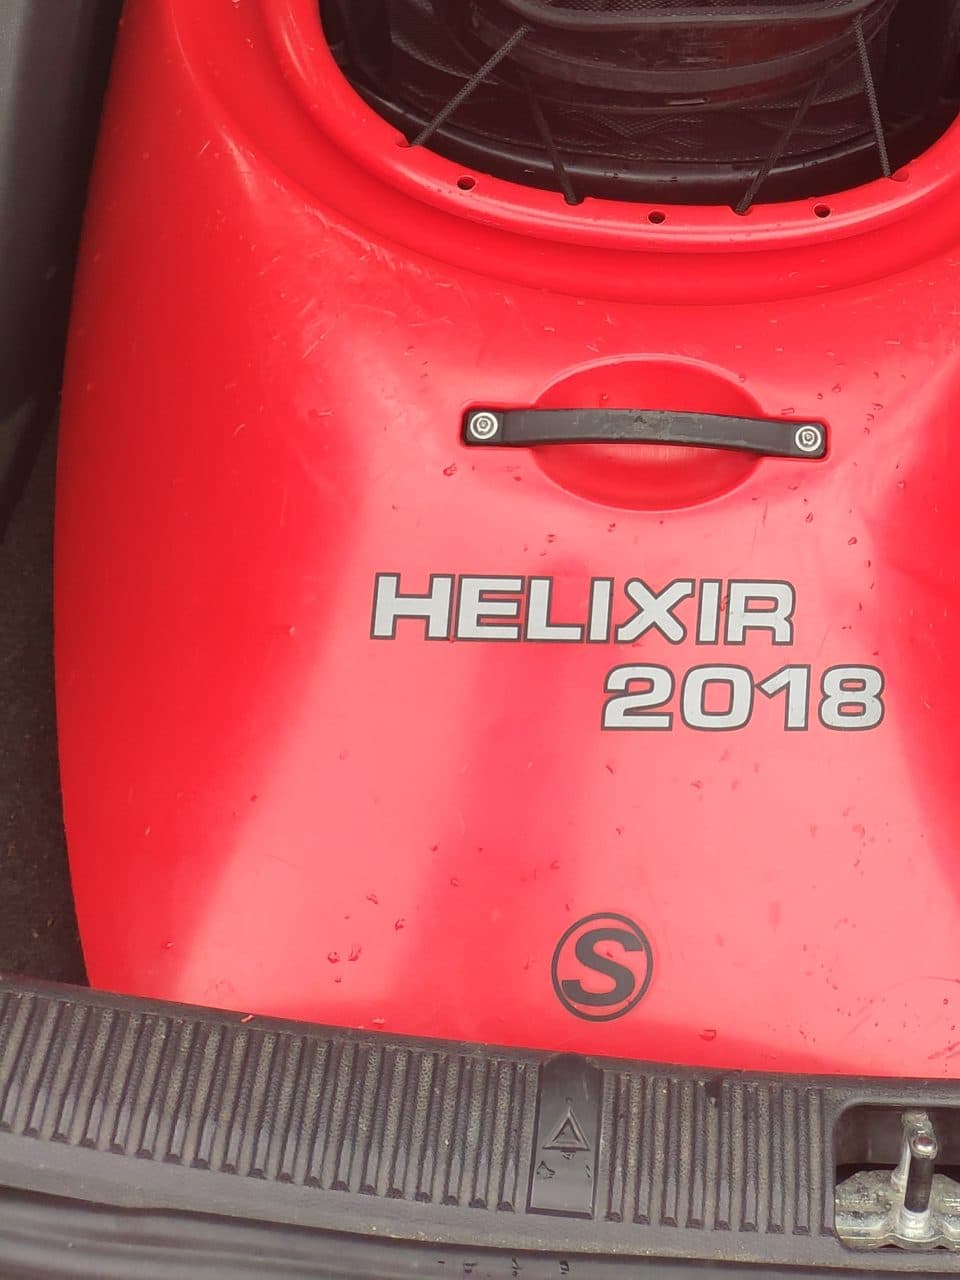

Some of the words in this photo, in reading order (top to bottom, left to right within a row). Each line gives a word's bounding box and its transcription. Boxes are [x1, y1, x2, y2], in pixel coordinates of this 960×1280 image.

[370, 573, 796, 645] HELIXIR
[600, 663, 886, 732] 2018
[558, 925, 646, 1008] S
